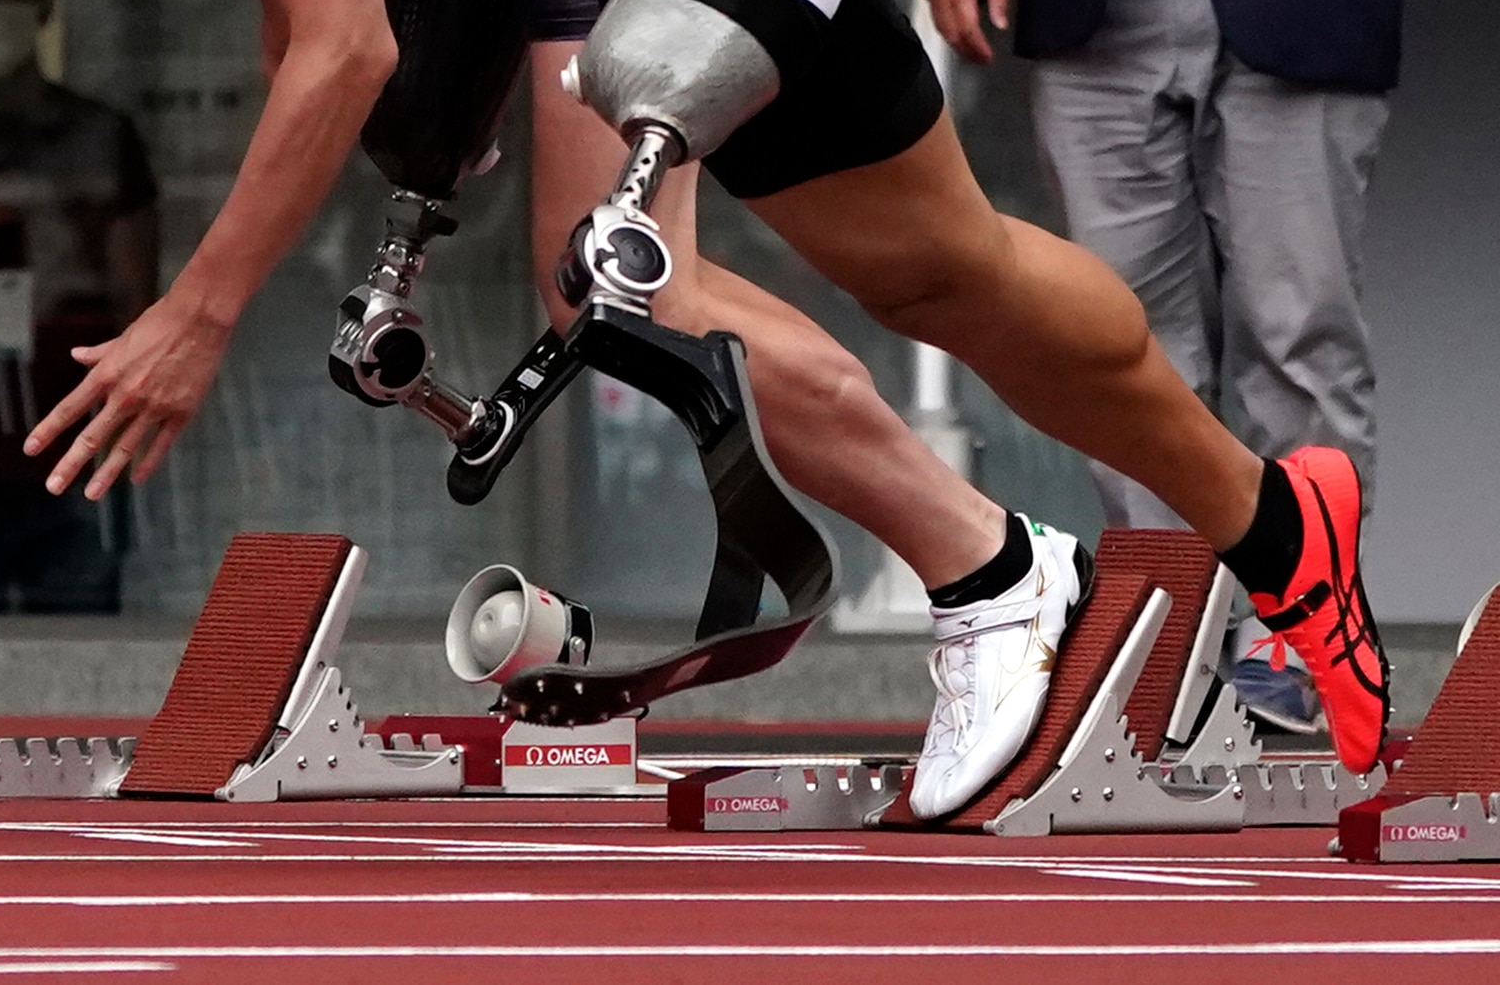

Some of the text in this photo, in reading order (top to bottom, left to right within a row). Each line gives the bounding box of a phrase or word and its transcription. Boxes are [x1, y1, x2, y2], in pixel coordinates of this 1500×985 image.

[547, 747, 610, 765] OMEGA
[731, 798, 780, 811] OMEGA
[1407, 826, 1457, 841] OMEGA
